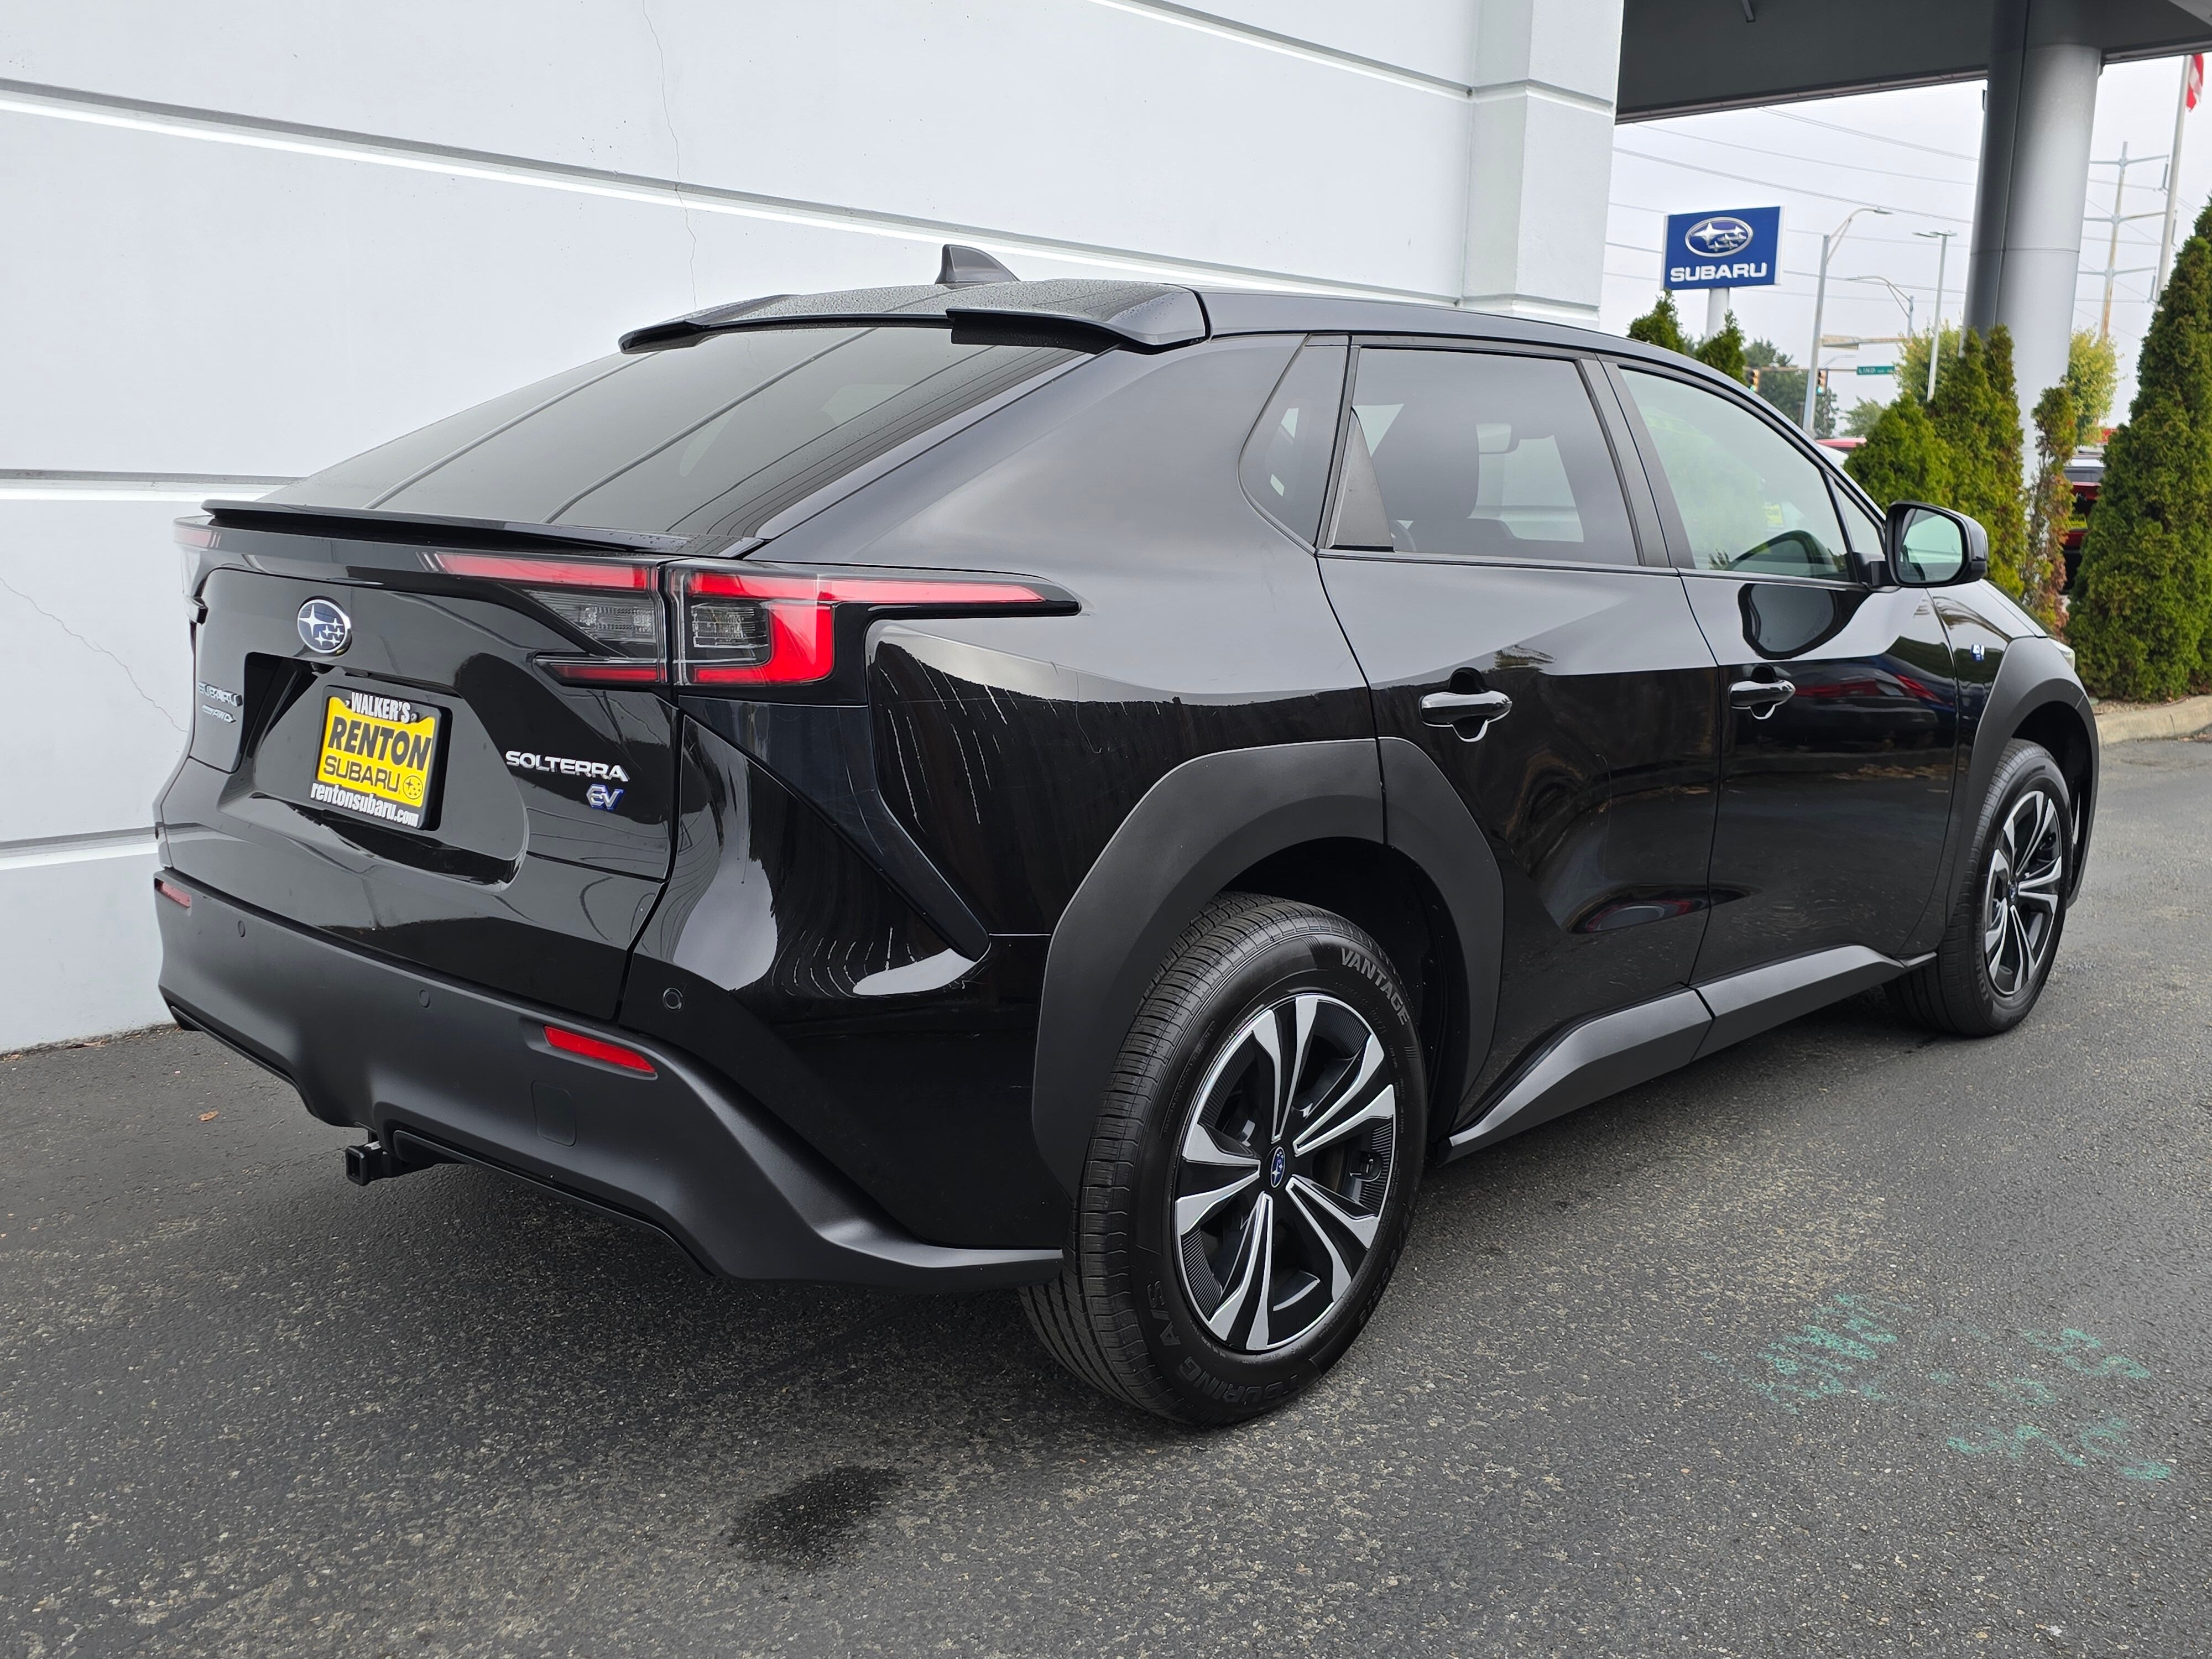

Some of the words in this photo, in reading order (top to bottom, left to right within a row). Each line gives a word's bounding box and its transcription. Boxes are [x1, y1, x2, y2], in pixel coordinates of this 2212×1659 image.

[1670, 262, 1767, 282] SUBARU
[197, 681, 241, 707] SUBARU
[351, 691, 411, 723] WALKER'S
[211, 709, 234, 723] AWD
[327, 715, 432, 771] RENTON
[323, 754, 401, 793] SUBARU
[505, 750, 630, 782] SOLTERRA
[310, 782, 420, 827] rentonsubaru.com
[586, 783, 625, 811] EV
[1340, 947, 1410, 1026] VANTAGE
[1146, 1280, 1182, 1346] A/S
[1177, 1356, 1300, 1405] TOURING
